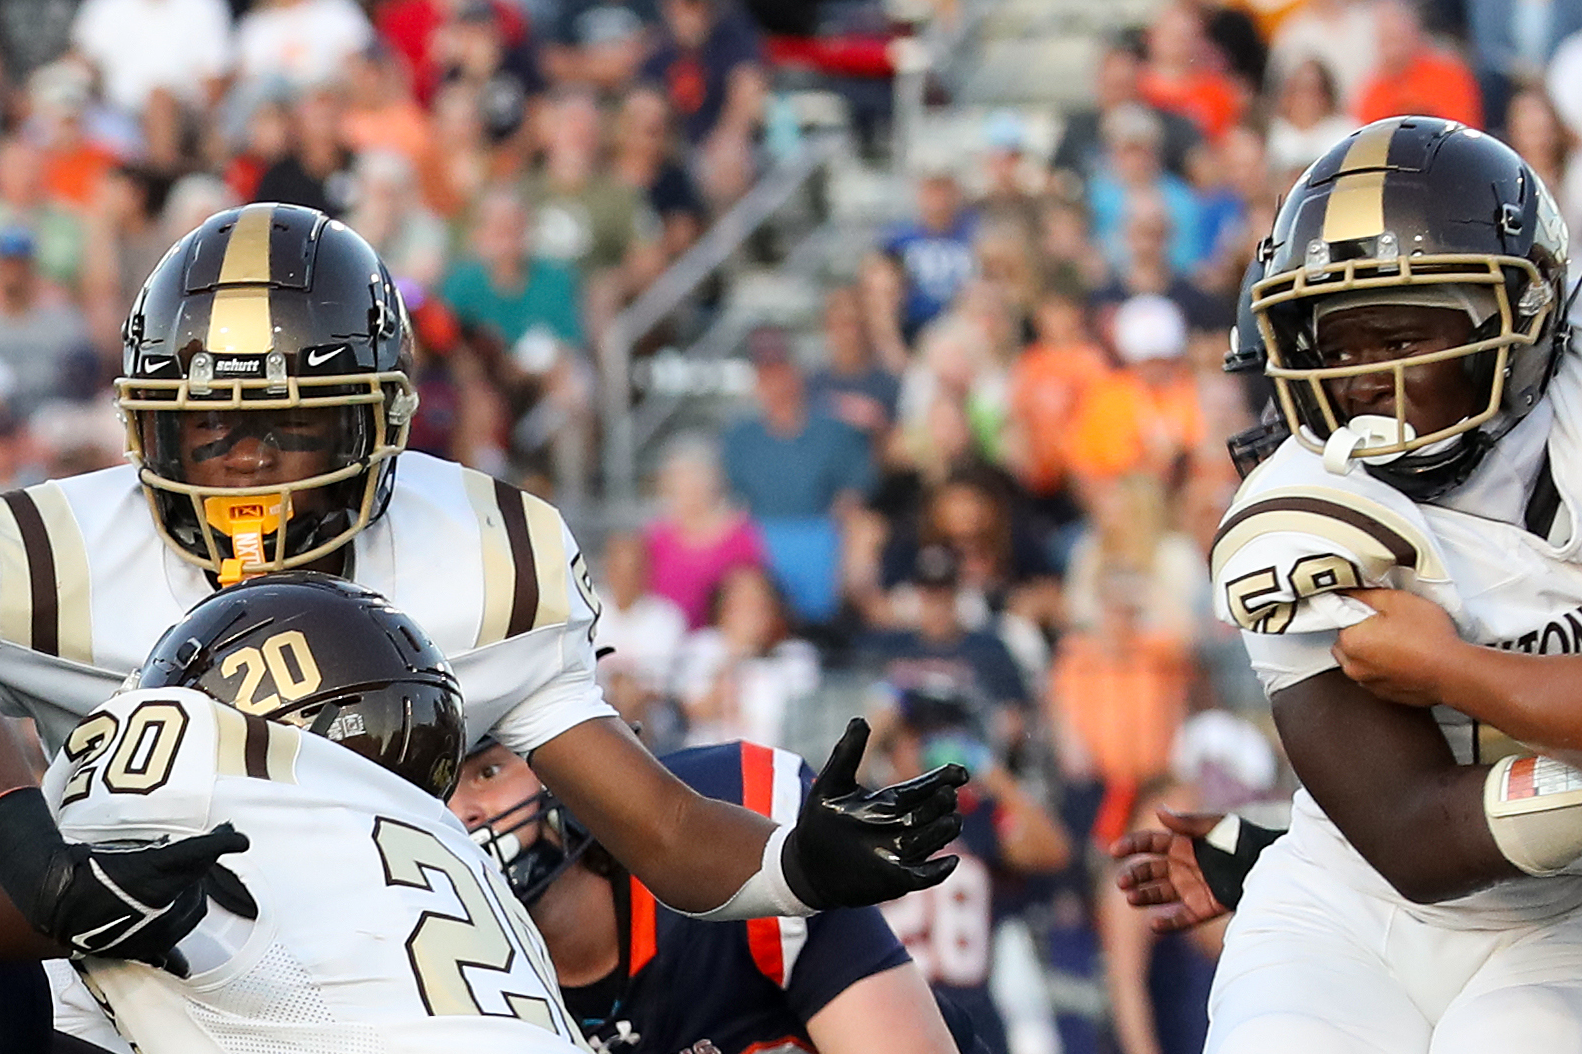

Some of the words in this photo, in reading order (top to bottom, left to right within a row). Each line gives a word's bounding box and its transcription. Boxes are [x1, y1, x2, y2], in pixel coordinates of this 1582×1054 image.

[215, 358, 259, 372] schutt
[220, 630, 323, 716] 20
[59, 700, 190, 810] 20
